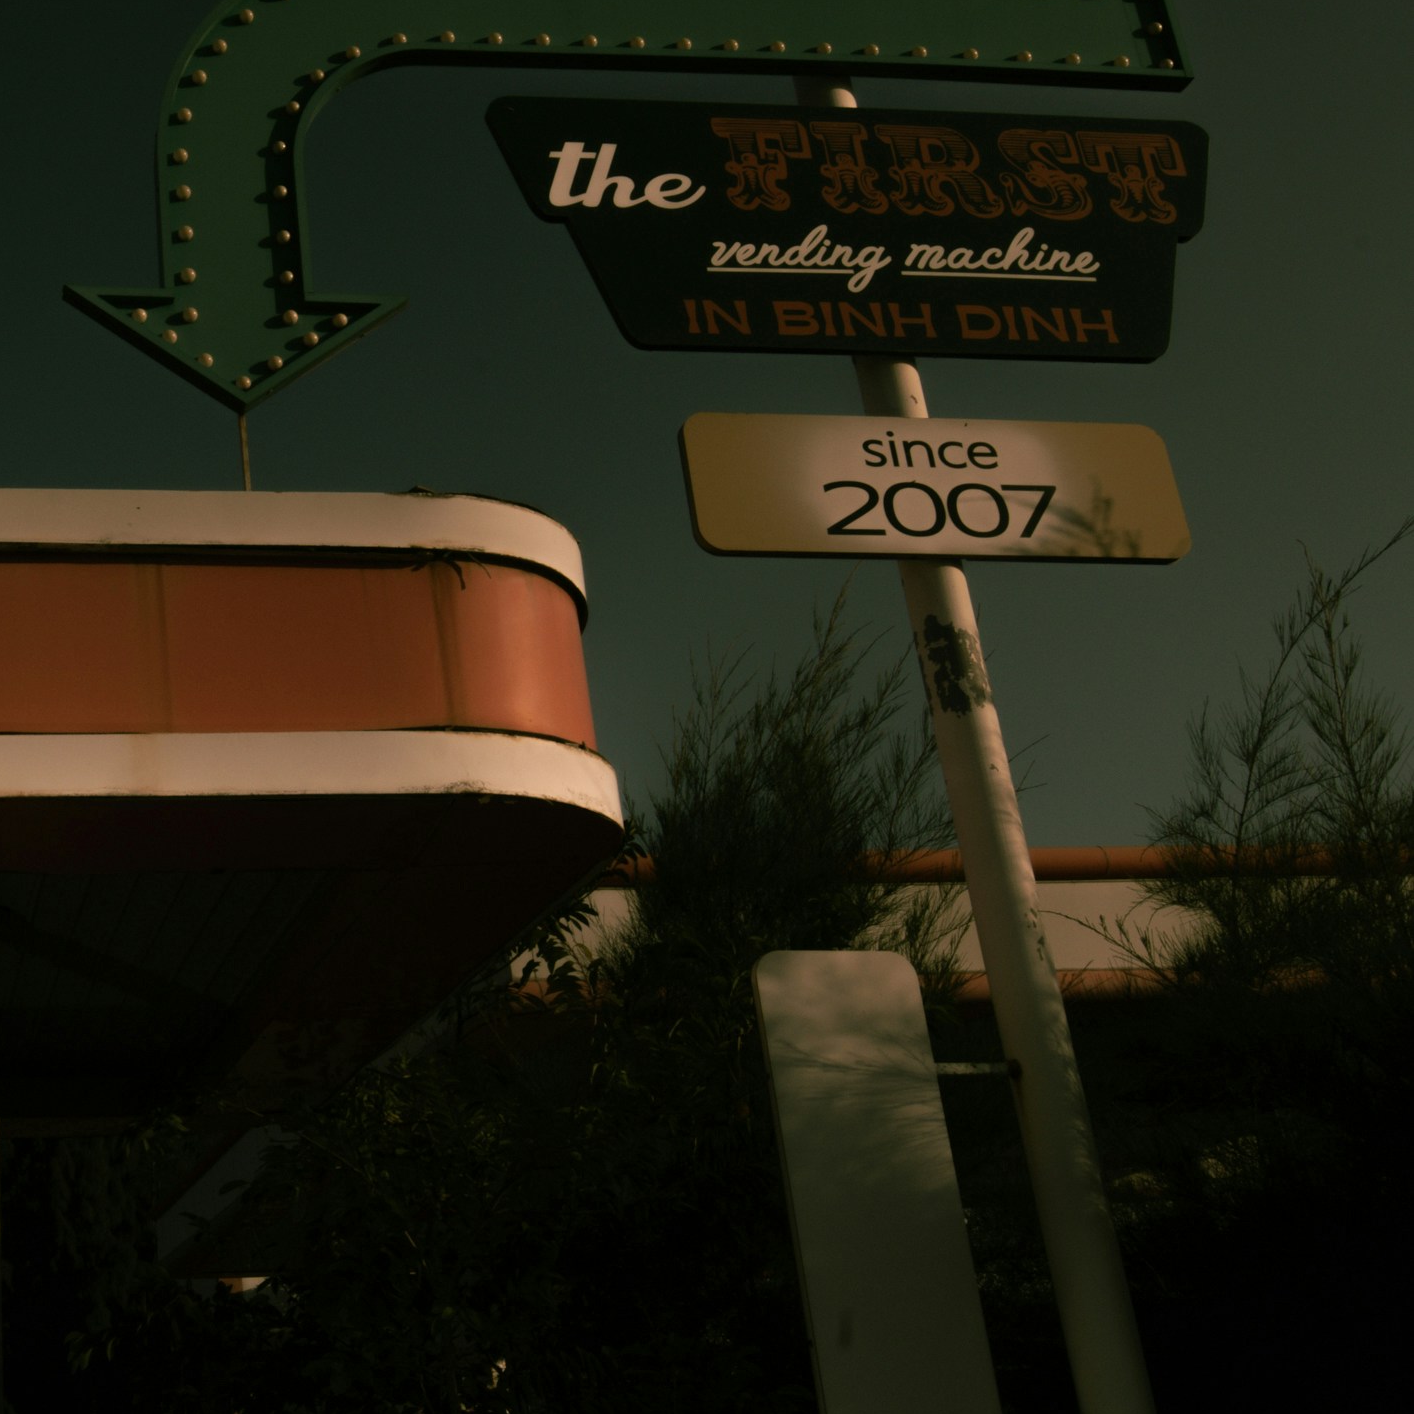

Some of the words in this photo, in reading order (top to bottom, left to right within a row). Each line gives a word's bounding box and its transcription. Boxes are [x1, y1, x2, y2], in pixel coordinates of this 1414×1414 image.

[547, 141, 707, 209] the
[710, 116, 1188, 225] FIRST
[707, 224, 892, 293] vending
[901, 227, 1102, 283] machine
[683, 298, 751, 335] IN
[772, 300, 937, 339] BINH
[955, 304, 1120, 344] DINH
[862, 430, 999, 470] since
[823, 480, 1057, 539] 2007
